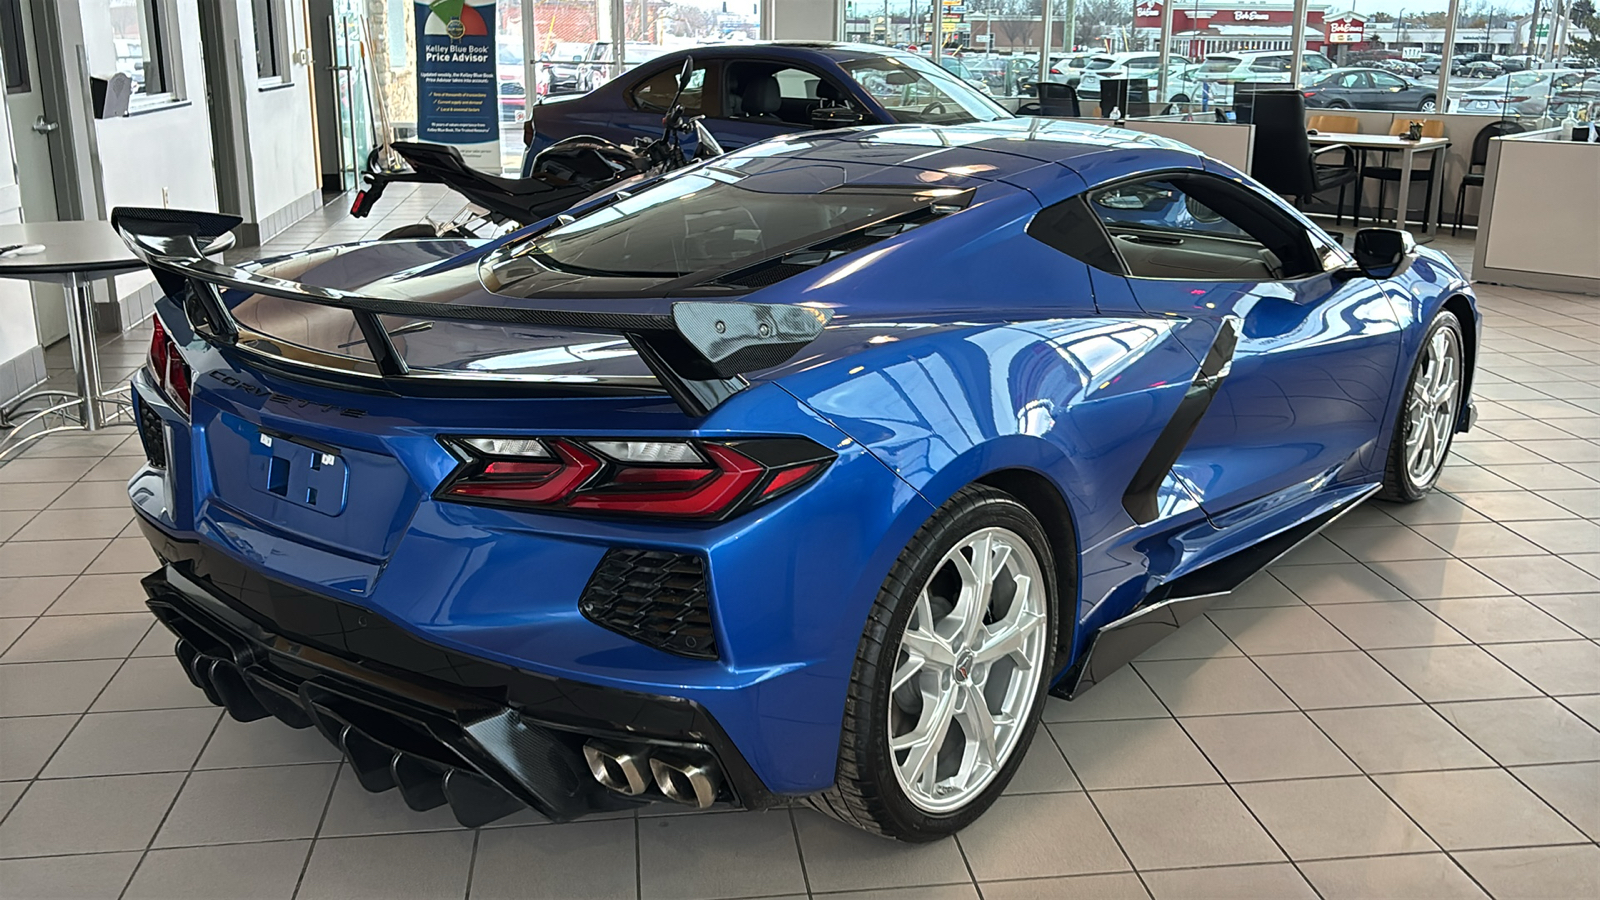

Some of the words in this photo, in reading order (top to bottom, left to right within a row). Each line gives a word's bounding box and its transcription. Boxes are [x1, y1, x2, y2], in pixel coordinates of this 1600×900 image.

[1234, 11, 1249, 21] Bob
[1331, 23, 1345, 33] Bob
[425, 45, 449, 54] Kelley
[450, 45, 467, 53] Blue
[426, 53, 450, 62] Price
[452, 53, 488, 63] Advisor
[208, 370, 368, 419] CORVETTE
